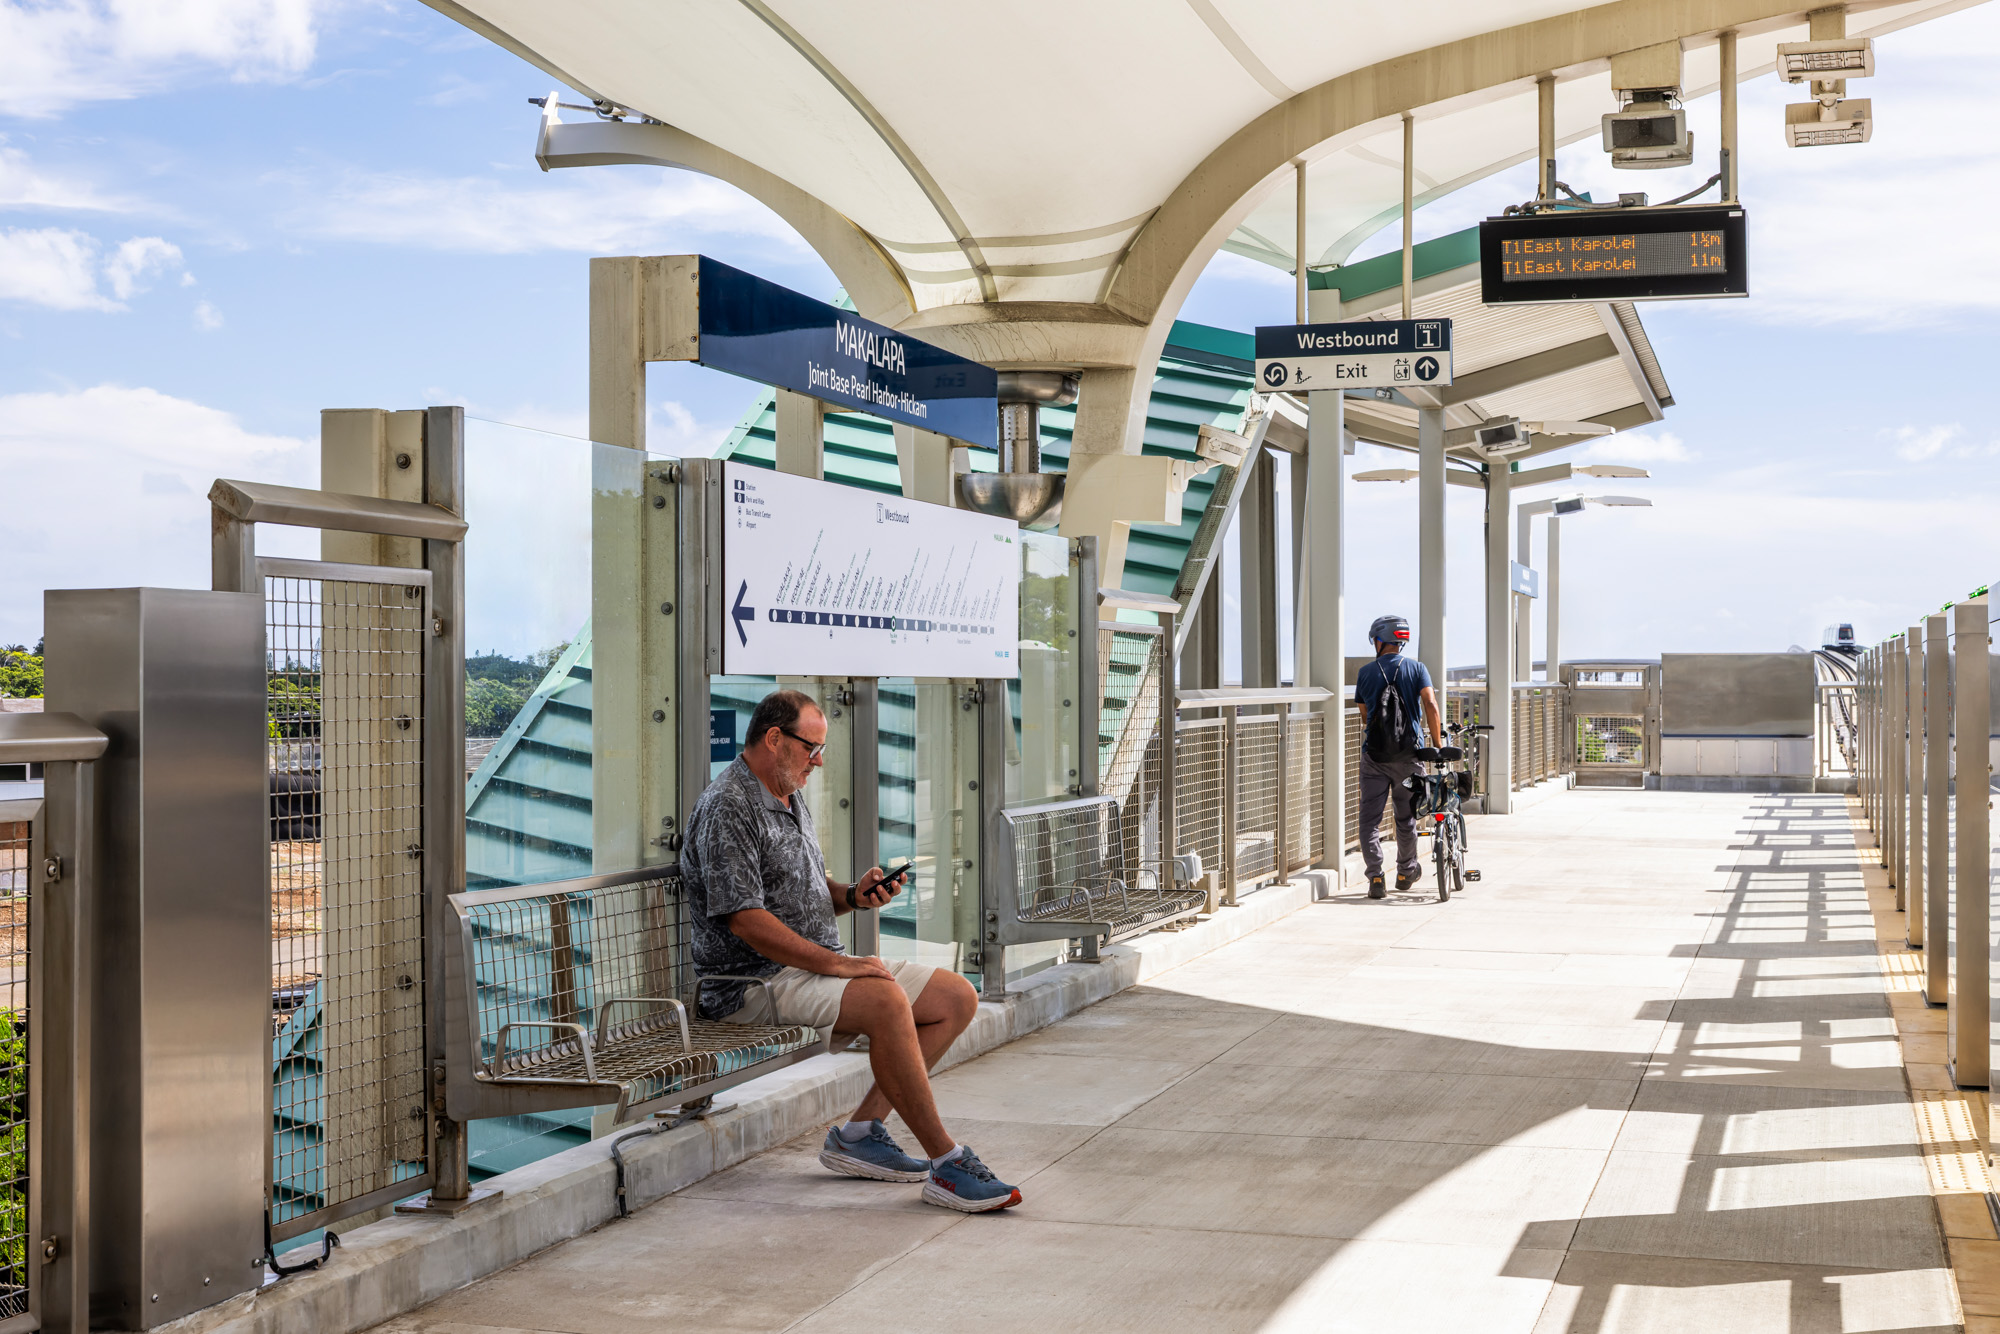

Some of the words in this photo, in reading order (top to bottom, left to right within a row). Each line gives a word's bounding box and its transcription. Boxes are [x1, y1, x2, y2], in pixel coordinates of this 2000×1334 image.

[1571, 235, 1636, 252] Kapolei
[1572, 256, 1636, 272] Kapolei
[1691, 253, 1721, 268] 11m
[835, 319, 906, 376] MAKALAPA
[1297, 328, 1399, 349] Westbound
[1422, 330, 1435, 347] 1
[1336, 363, 1368, 379] Exit
[808, 360, 829, 389] Joint
[830, 368, 850, 395] Base
[851, 374, 871, 402] Pearl
[885, 508, 910, 524] Westbound
[932, 1173, 956, 1193] HOKA
